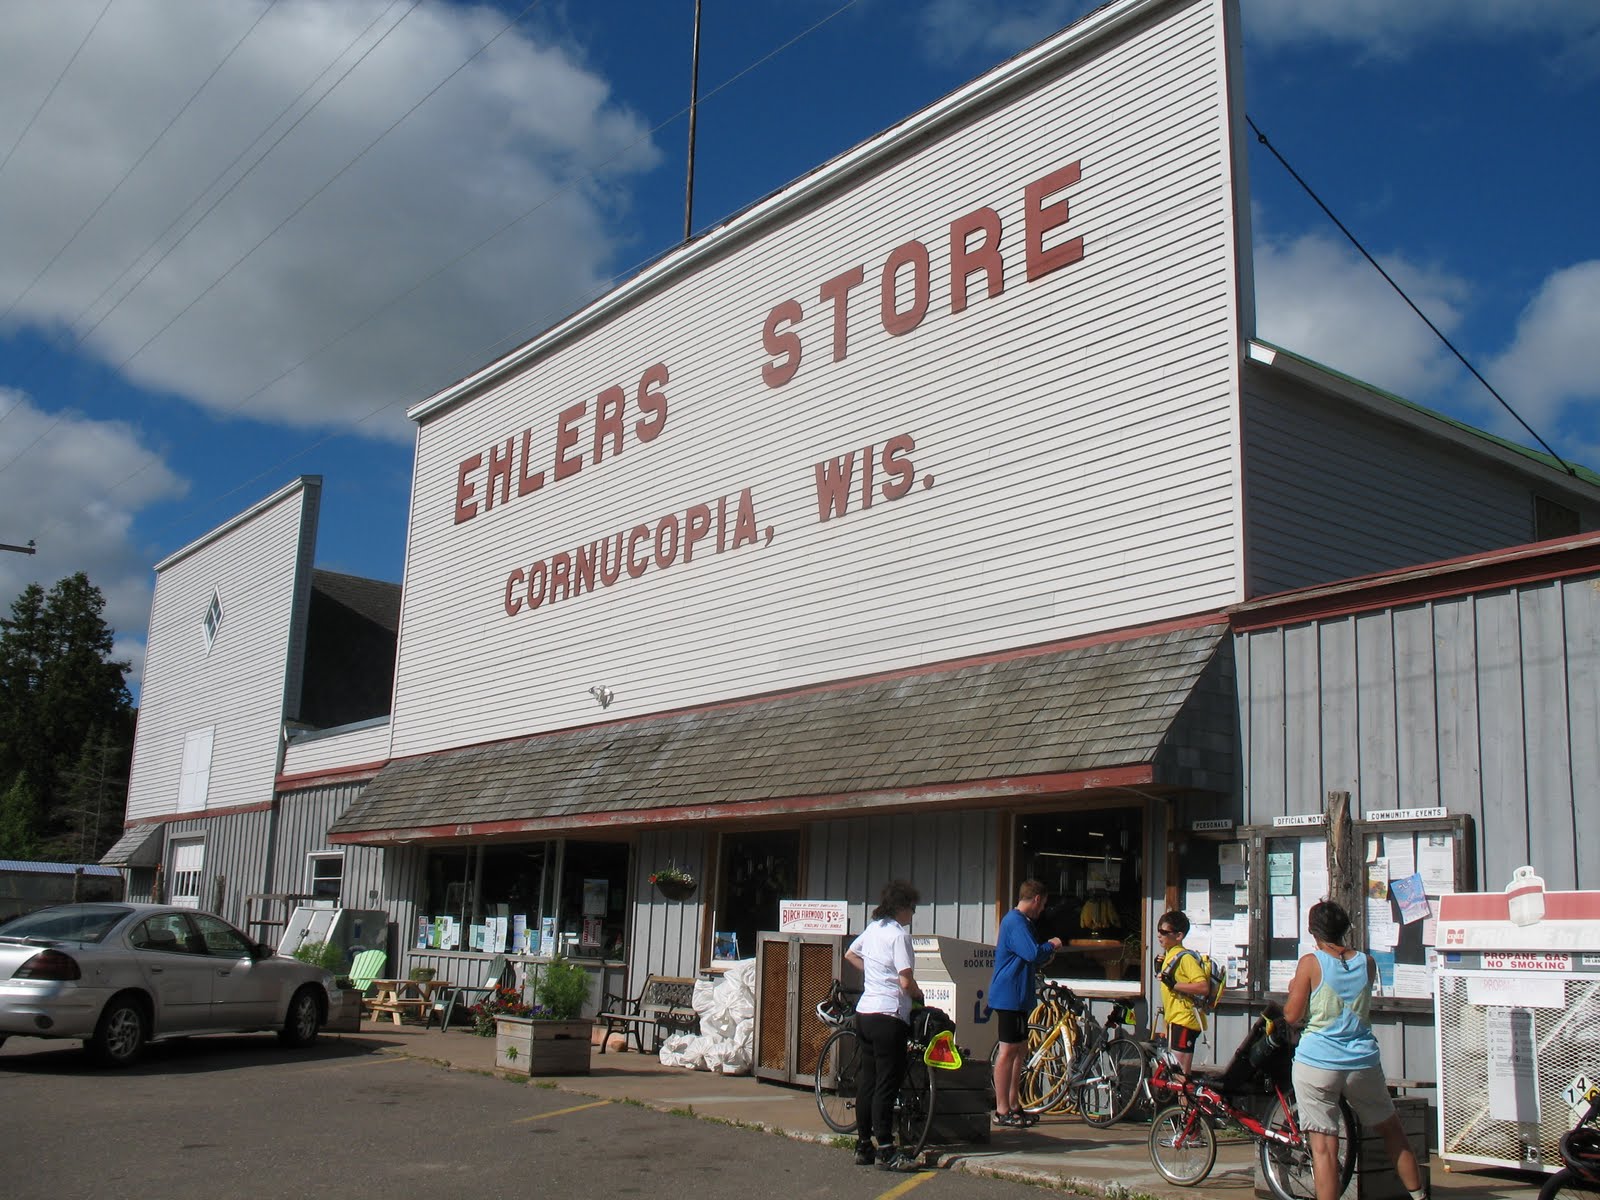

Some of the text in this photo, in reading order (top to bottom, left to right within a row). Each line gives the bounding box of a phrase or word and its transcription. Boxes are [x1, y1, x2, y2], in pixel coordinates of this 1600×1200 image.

[454, 158, 1085, 526] EHLERS STORE
[504, 433, 935, 617] CORNUCOPIA, WIS.
[1371, 808, 1442, 820] COMMUNITY EVENTS
[1195, 821, 1228, 829] PERSONALS
[1277, 816, 1305, 825] OFFICIAL
[783, 909, 800, 925] BIRCH
[801, 910, 824, 920] FIREWOOD
[1484, 952, 1569, 962] PROPANE GAS
[963, 959, 984, 968] BOOK
[1510, 961, 1565, 970] SMOKING
[1576, 1077, 1587, 1092] 4
[1567, 1088, 1574, 1103] 1
